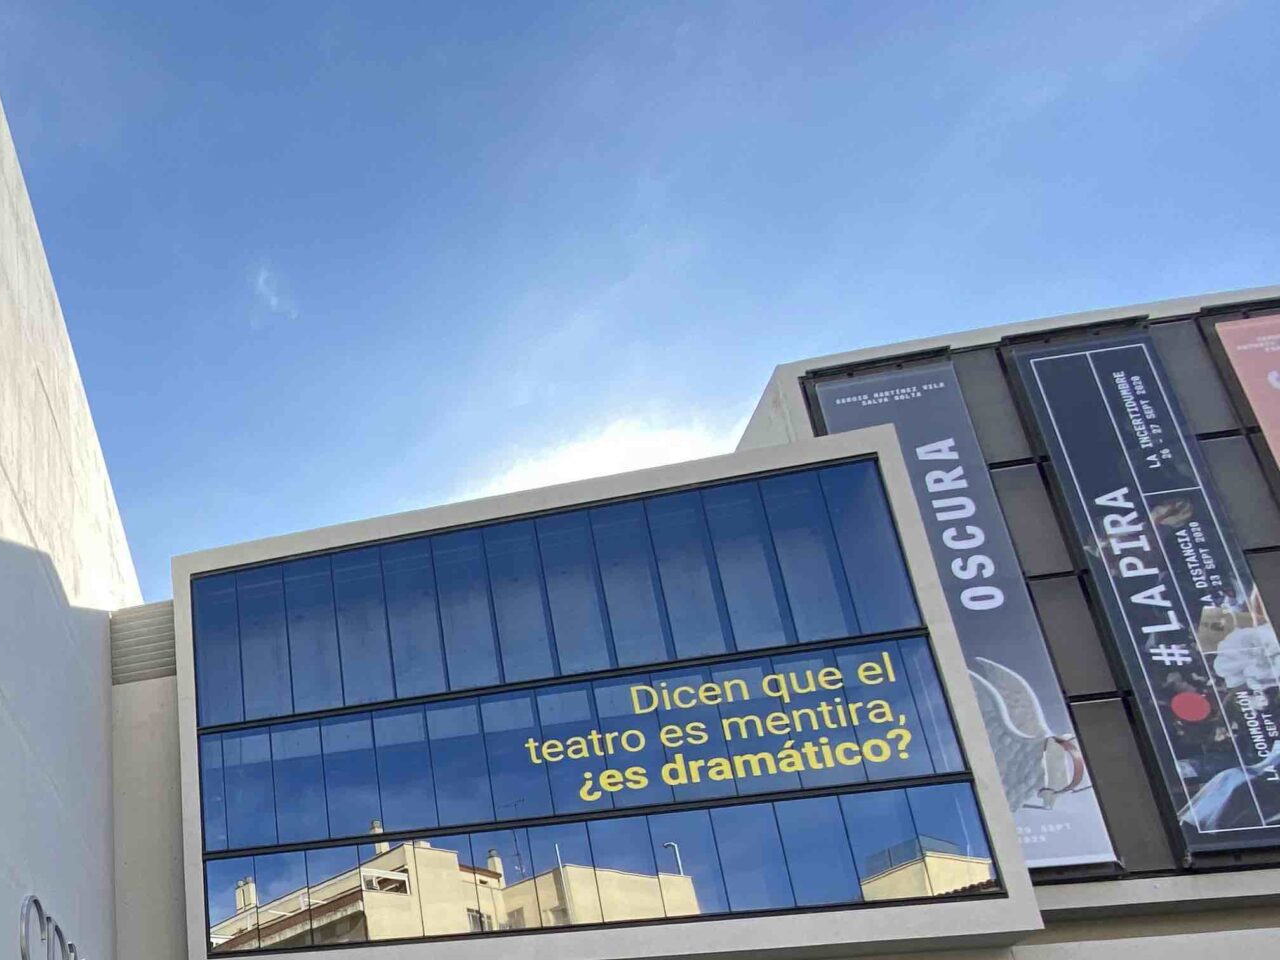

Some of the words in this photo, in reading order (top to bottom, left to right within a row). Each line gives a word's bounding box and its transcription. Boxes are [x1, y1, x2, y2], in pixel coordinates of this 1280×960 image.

[1130, 375, 1147, 395] 2020
[1112, 370, 1154, 449] INCERTIDUMBRE
[1139, 399, 1156, 420] SEPT
[1146, 453, 1161, 469] LA
[916, 437, 1005, 611] OSCURA
[1188, 521, 1206, 543] 2020
[1175, 529, 1209, 589] DISTANCIA
[1199, 546, 1216, 570] SEPT
[1210, 574, 1222, 586] 23
[630, 679, 750, 715] Dicen
[762, 666, 844, 704] que
[857, 651, 897, 685] el
[525, 729, 646, 765] teatro
[660, 721, 709, 748] es
[721, 697, 907, 742] mentira,
[1235, 691, 1270, 758] CONMOCIÓN
[1261, 713, 1279, 737] SEPT
[578, 766, 650, 802] ¿es
[661, 728, 913, 786] dramático?
